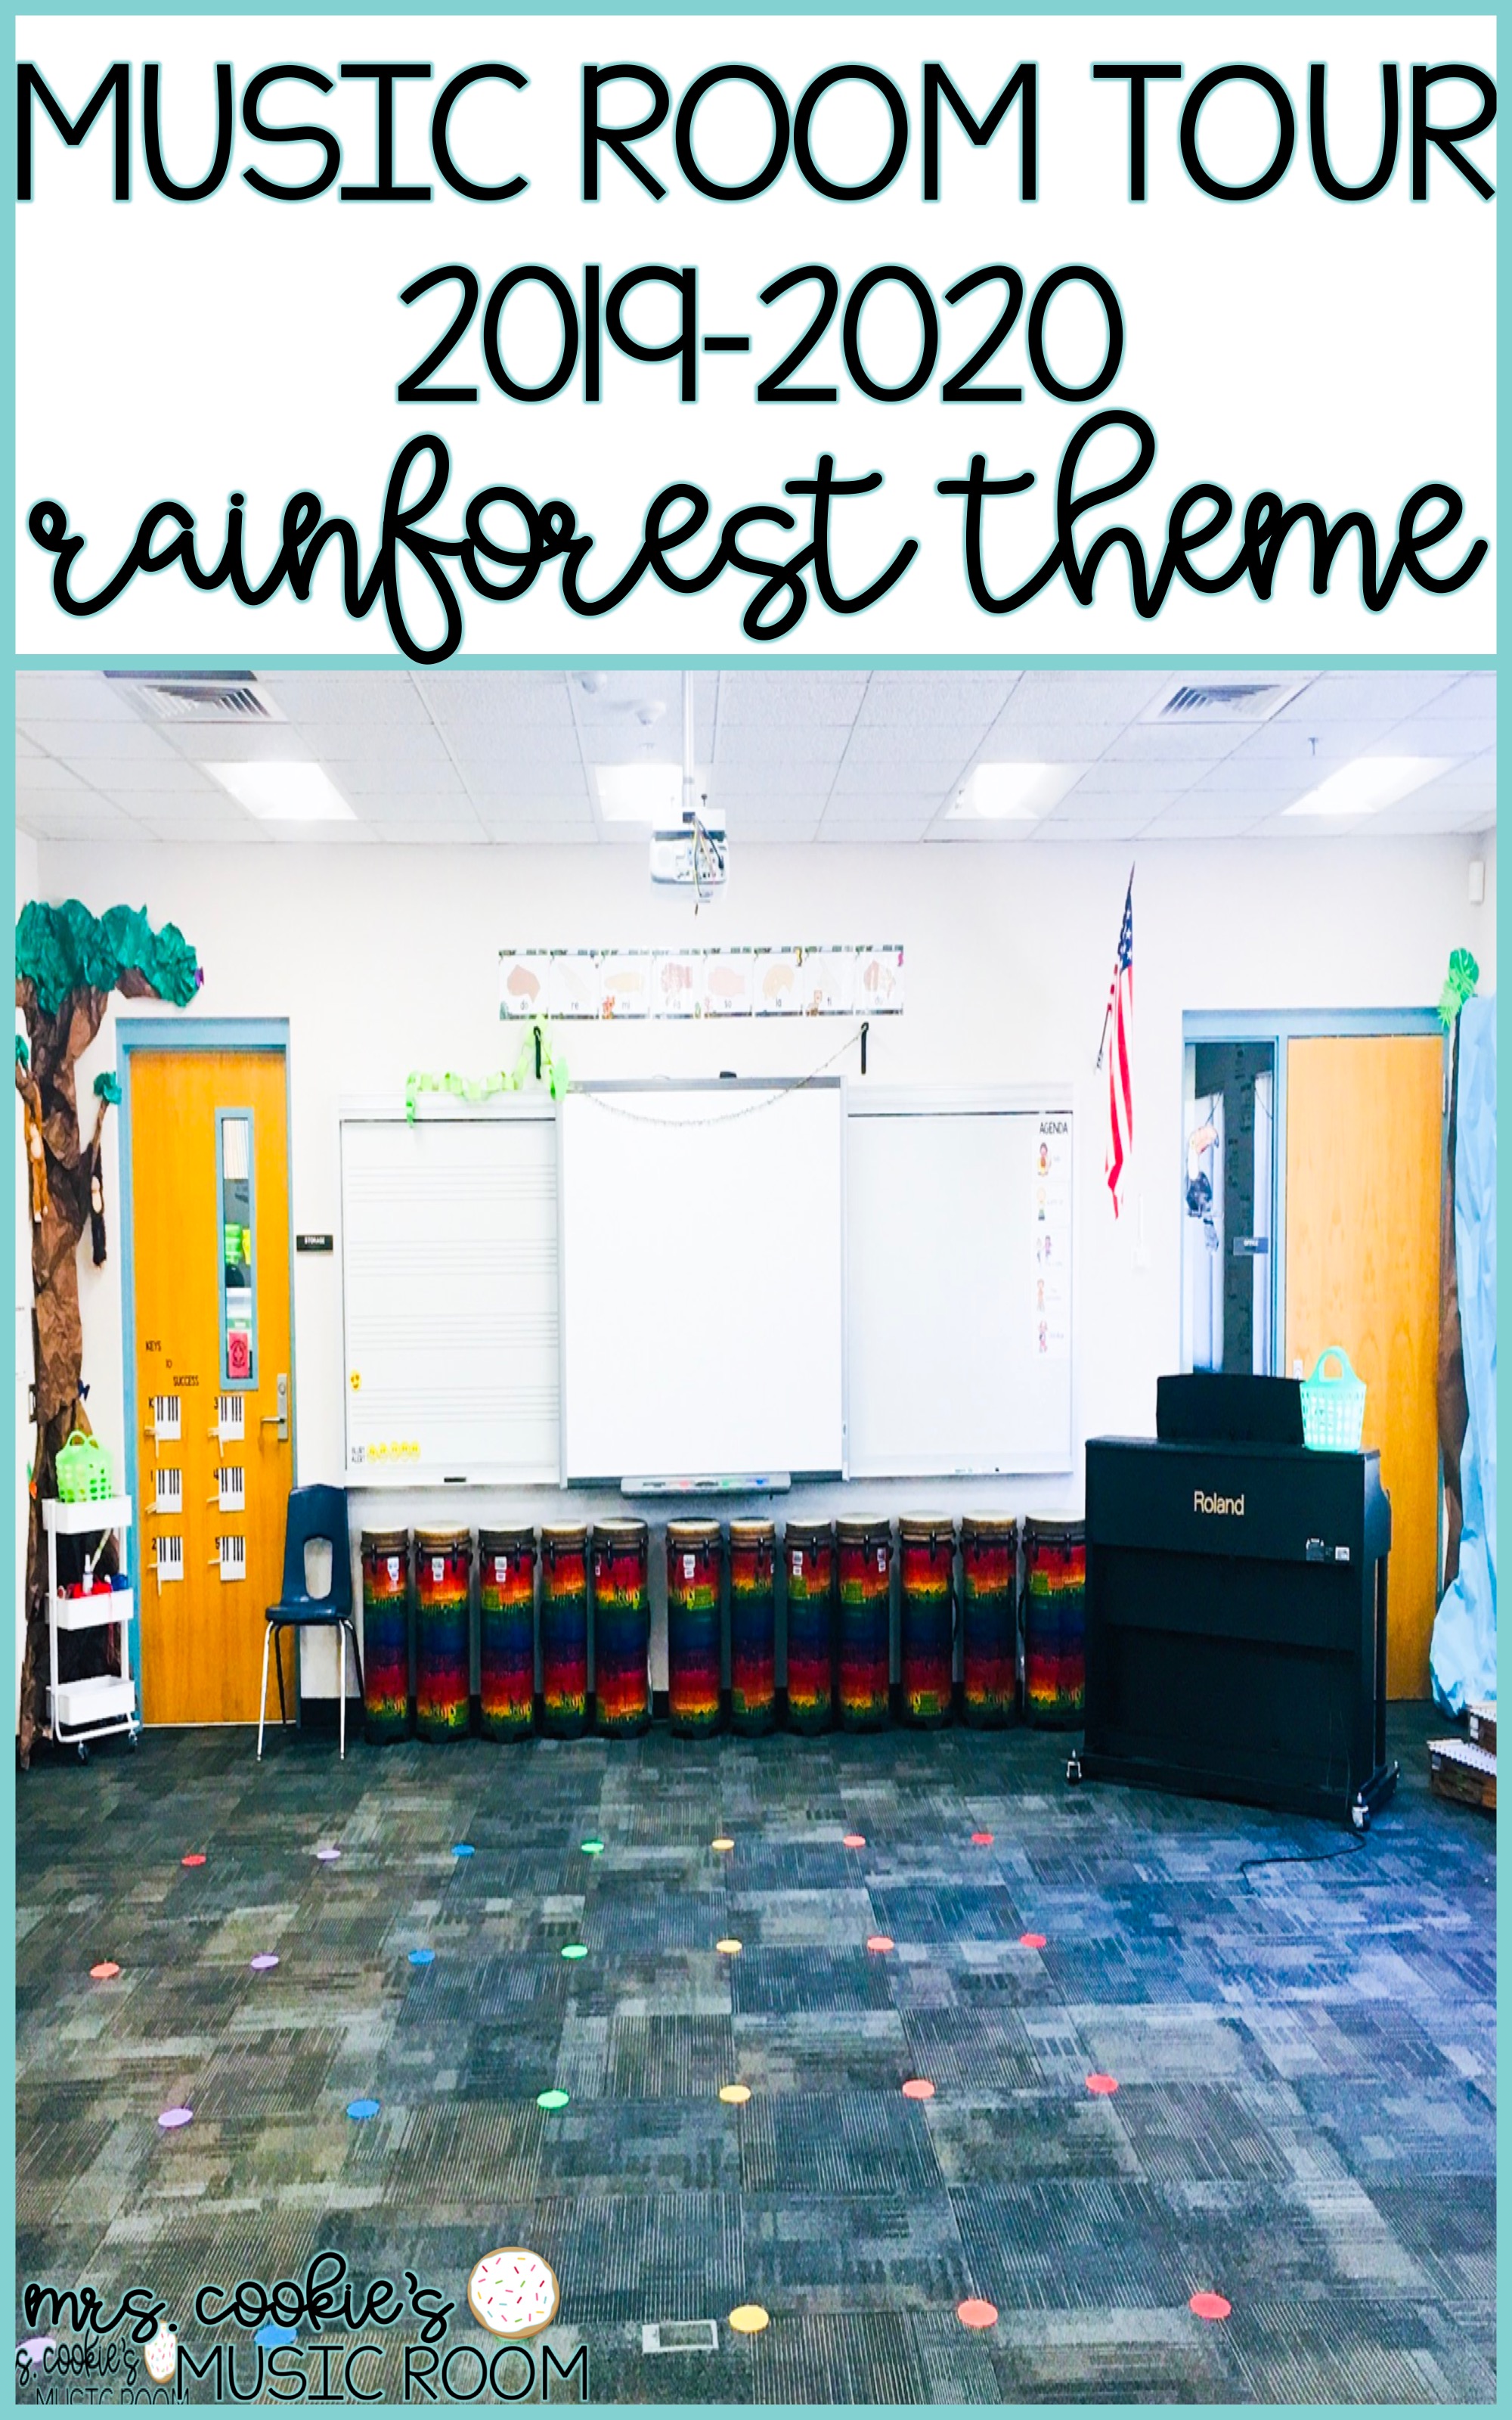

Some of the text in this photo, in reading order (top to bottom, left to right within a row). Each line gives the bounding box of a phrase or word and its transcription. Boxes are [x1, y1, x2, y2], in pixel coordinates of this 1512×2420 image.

[1040, 1122, 1069, 1134] AGENDA
[145, 1340, 162, 1352] KEYS
[173, 1375, 200, 1387] SUCCESS
[148, 1397, 154, 1409] K
[213, 1397, 219, 1410] 3
[1194, 1491, 1244, 1516] Roland
[152, 1536, 157, 1551] 2
[215, 1536, 220, 1550] 5
